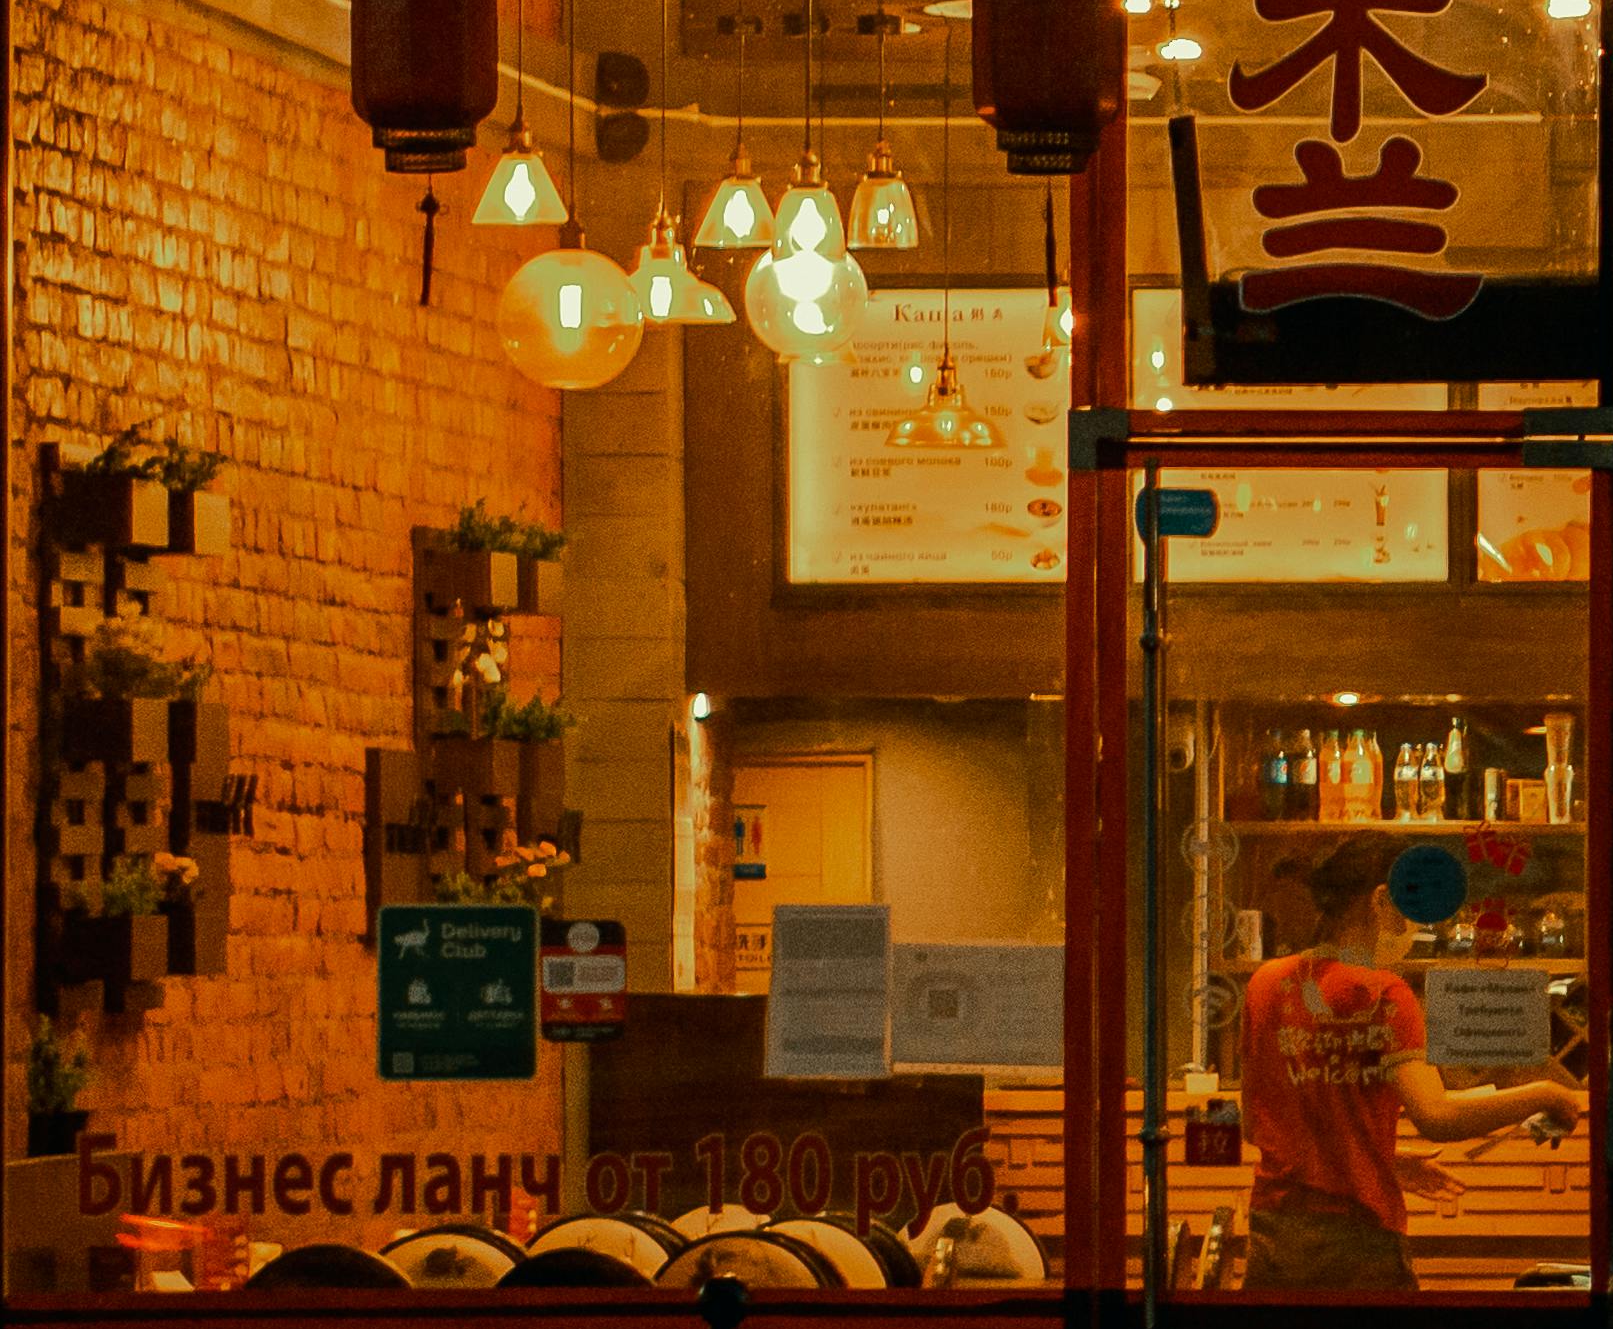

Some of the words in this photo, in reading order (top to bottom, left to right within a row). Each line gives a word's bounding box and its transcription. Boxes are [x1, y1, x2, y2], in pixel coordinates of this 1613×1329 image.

[441, 923, 523, 942] Delivery
[441, 942, 487, 959] Club
[78, 1133, 354, 1215] Бизнес
[373, 1152, 561, 1216] ланч
[586, 1152, 673, 1214] от
[695, 1132, 832, 1216] 180
